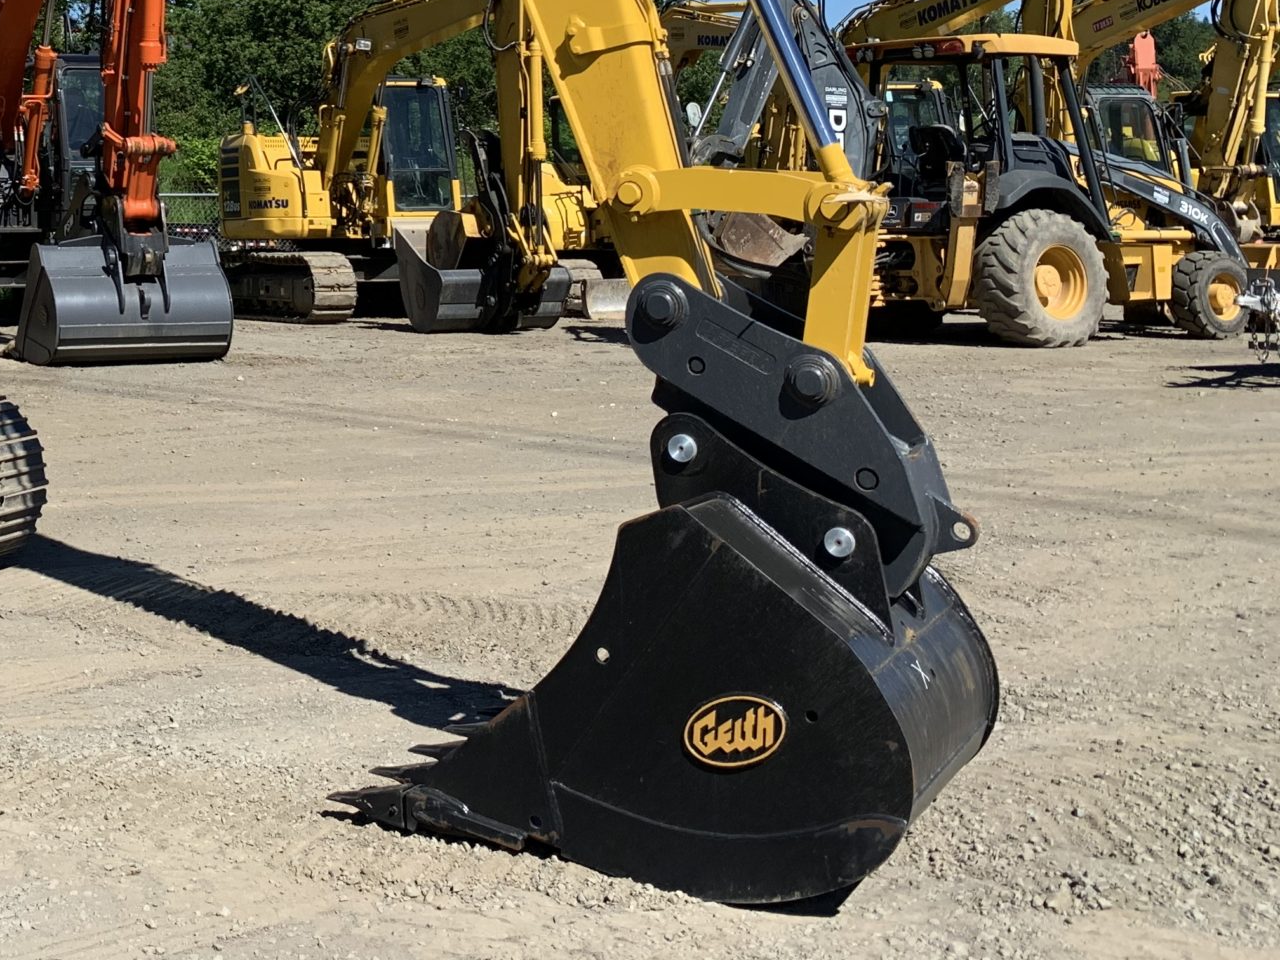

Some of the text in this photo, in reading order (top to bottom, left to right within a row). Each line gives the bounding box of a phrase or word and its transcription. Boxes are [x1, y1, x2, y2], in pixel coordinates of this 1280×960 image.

[697, 32, 733, 47] KOMA
[248, 197, 290, 210] KOMATSU
[1179, 200, 1209, 225] 310K
[692, 705, 776, 756] Geith
